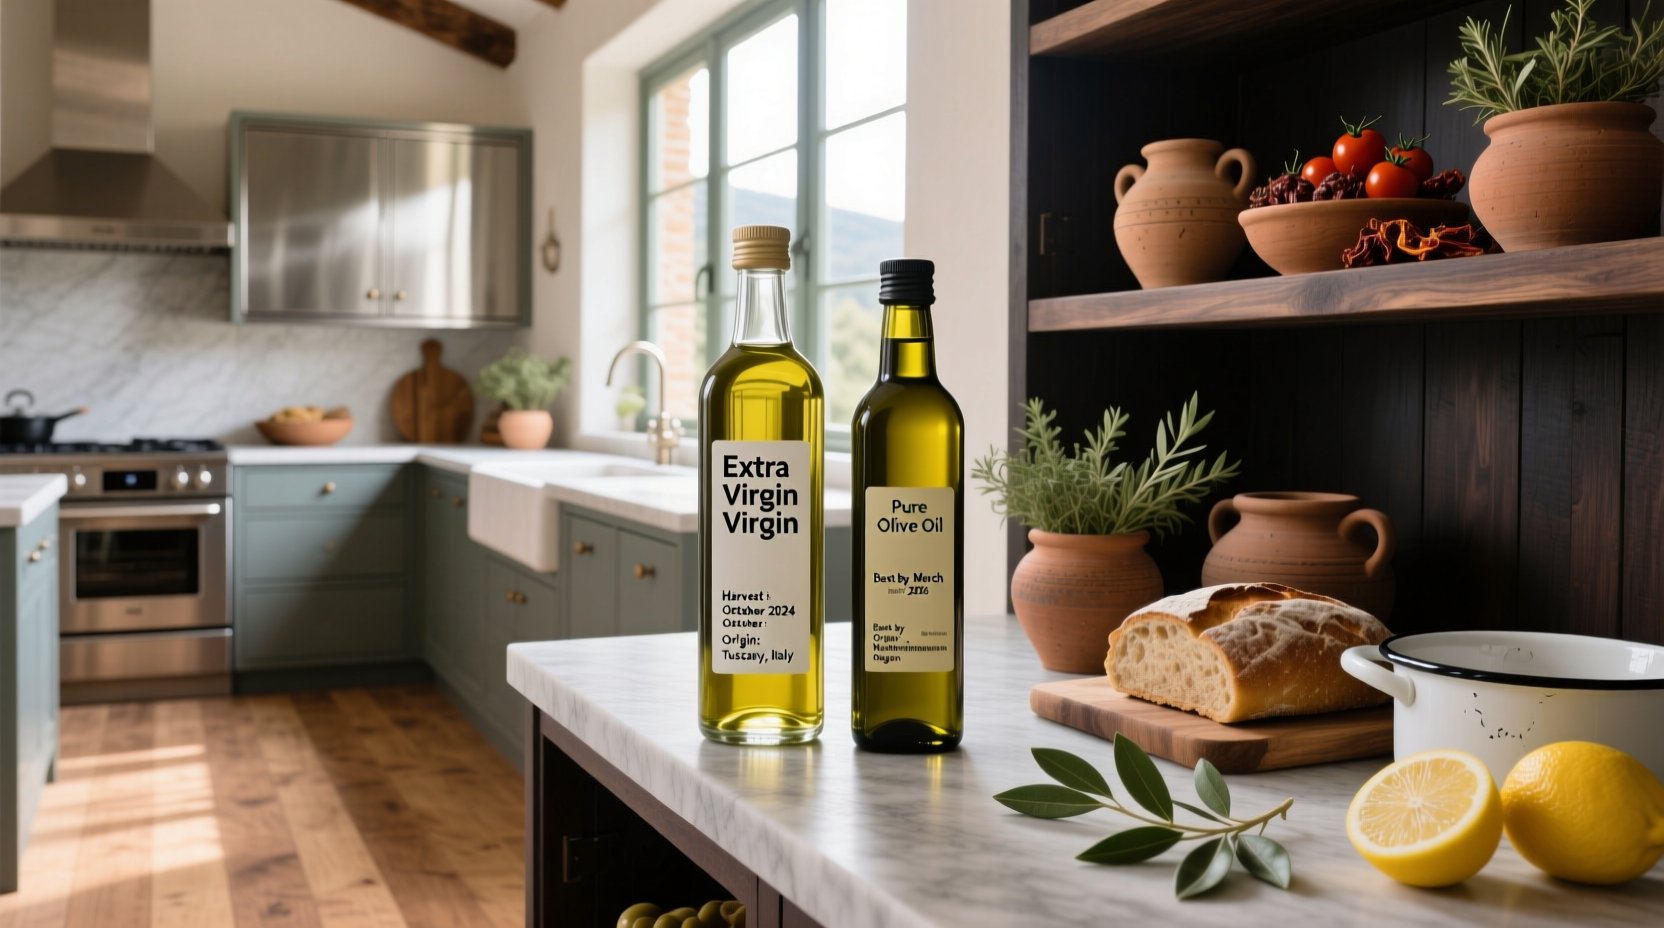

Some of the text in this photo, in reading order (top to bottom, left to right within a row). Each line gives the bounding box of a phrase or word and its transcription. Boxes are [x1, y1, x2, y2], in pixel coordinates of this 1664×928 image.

[723, 455, 789, 478] Extra
[722, 483, 798, 512] Virgin
[892, 499, 928, 514] Pure
[722, 511, 799, 540] Virgin
[877, 516, 943, 533] Olive Oil
[897, 572, 910, 585] by
[768, 605, 796, 616] 2024
